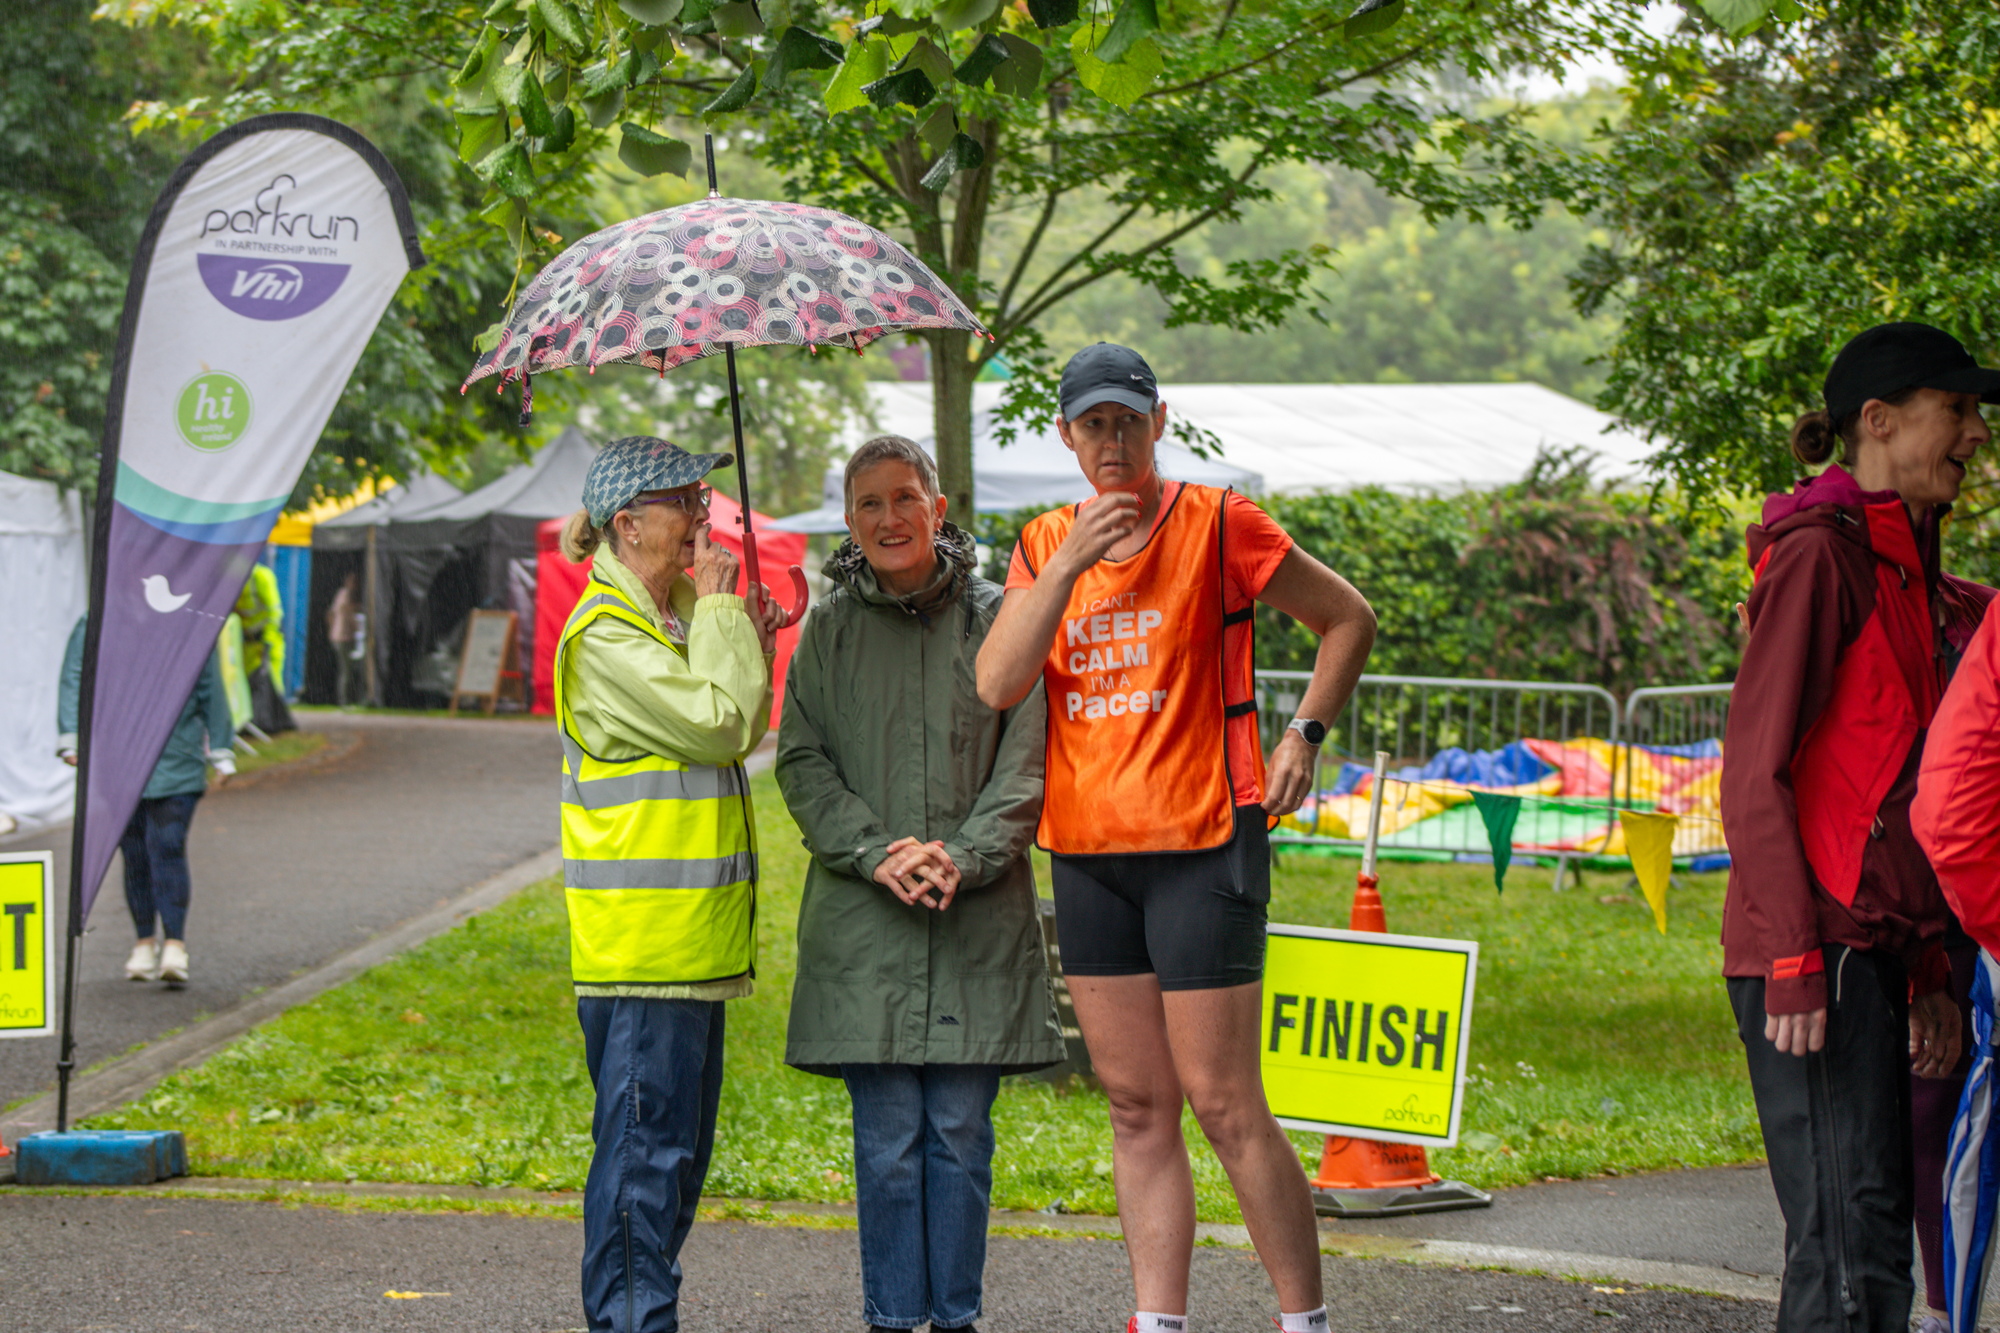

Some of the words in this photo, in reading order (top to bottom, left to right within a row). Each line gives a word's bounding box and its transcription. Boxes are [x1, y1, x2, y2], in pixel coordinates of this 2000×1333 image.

[199, 174, 359, 241] parkrun
[215, 239, 228, 249] IN
[230, 240, 305, 254] PARTNERSHIP
[307, 246, 338, 257] WITH
[230, 265, 301, 302] Vhi
[194, 383, 235, 420] hi
[1081, 602, 1087, 614] I
[1090, 592, 1138, 612] CAN'T
[1066, 609, 1163, 647] KEEP
[1069, 642, 1149, 675] CALM
[1090, 675, 1115, 692] I'M
[1119, 673, 1132, 688] A
[1066, 689, 1167, 721] Pacer
[1268, 992, 1449, 1072] FINISH
[1383, 1093, 1441, 1125] parkrun
[1157, 1317, 1183, 1331] PUMA
